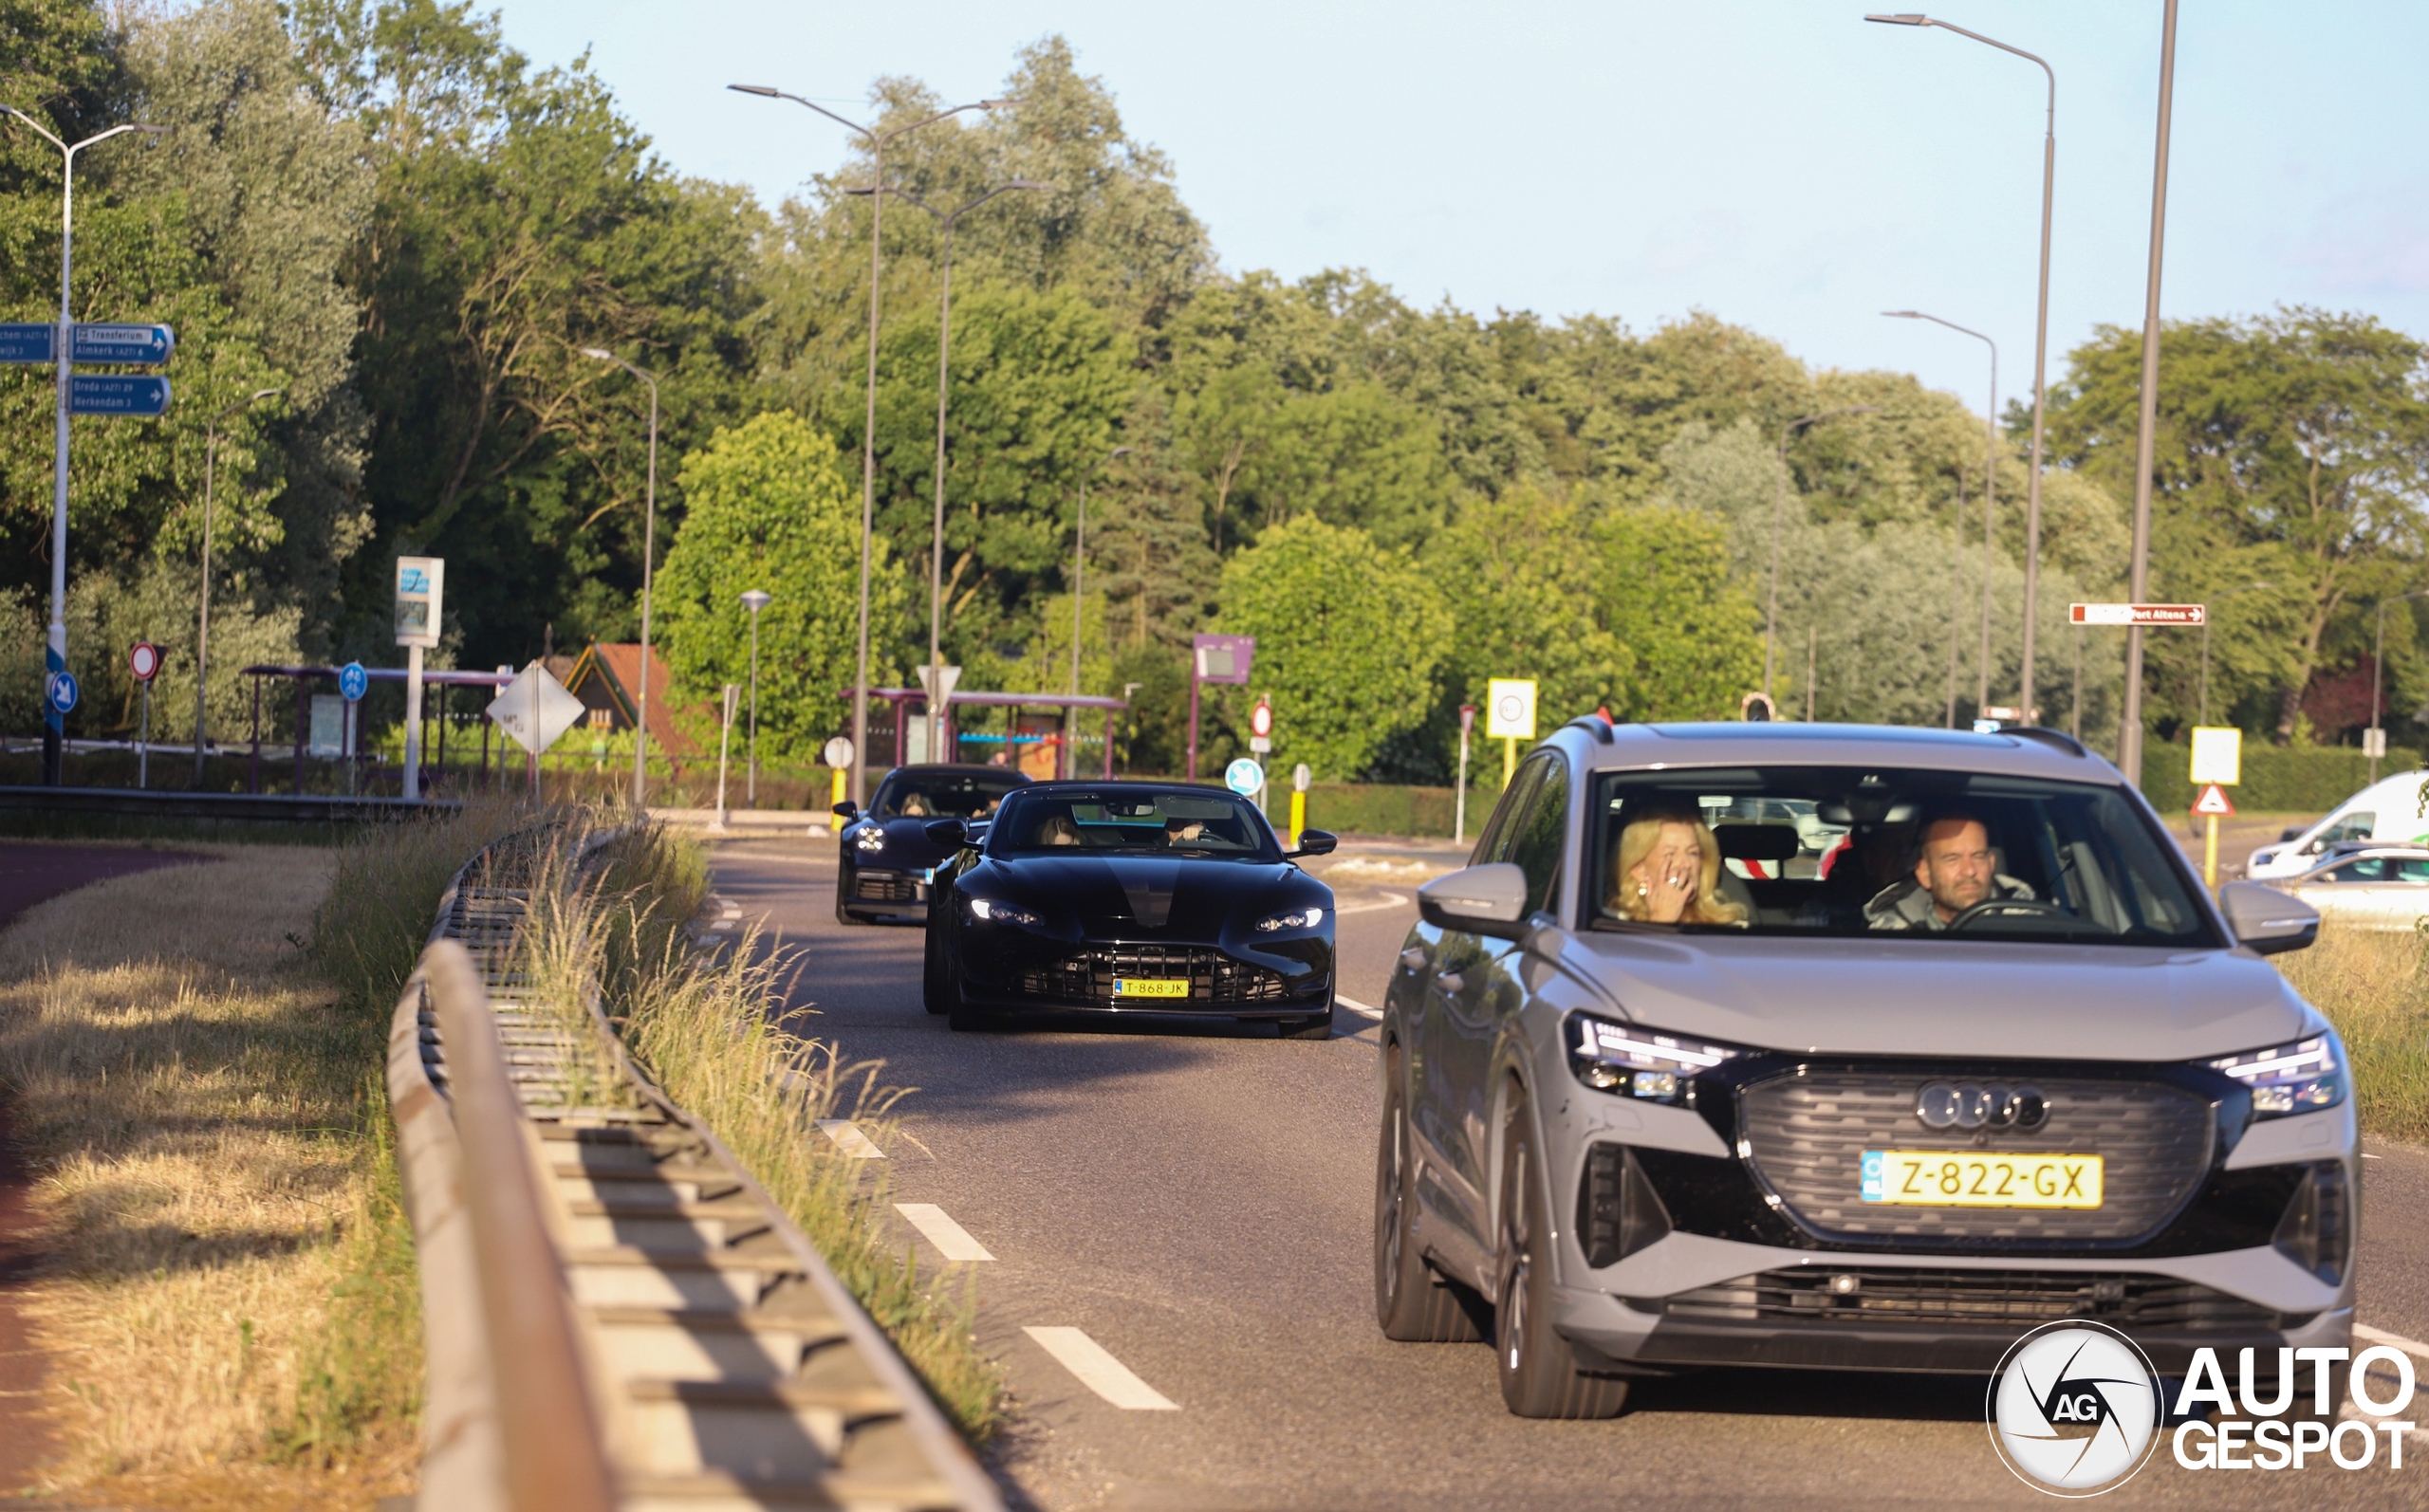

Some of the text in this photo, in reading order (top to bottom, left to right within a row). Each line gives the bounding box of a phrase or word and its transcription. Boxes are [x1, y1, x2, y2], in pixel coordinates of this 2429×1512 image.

[92, 329, 143, 341] Transferium
[75, 344, 113, 355] Almkerk
[116, 347, 136, 357] (A27)
[74, 380, 100, 392] Breda
[102, 382, 121, 393] (A27)
[74, 396, 124, 407] Werkendam
[2153, 609, 2187, 620] Altena
[1126, 983, 1183, 994] T-868-JK
[1901, 1161, 2084, 1198] Z-822-GX
